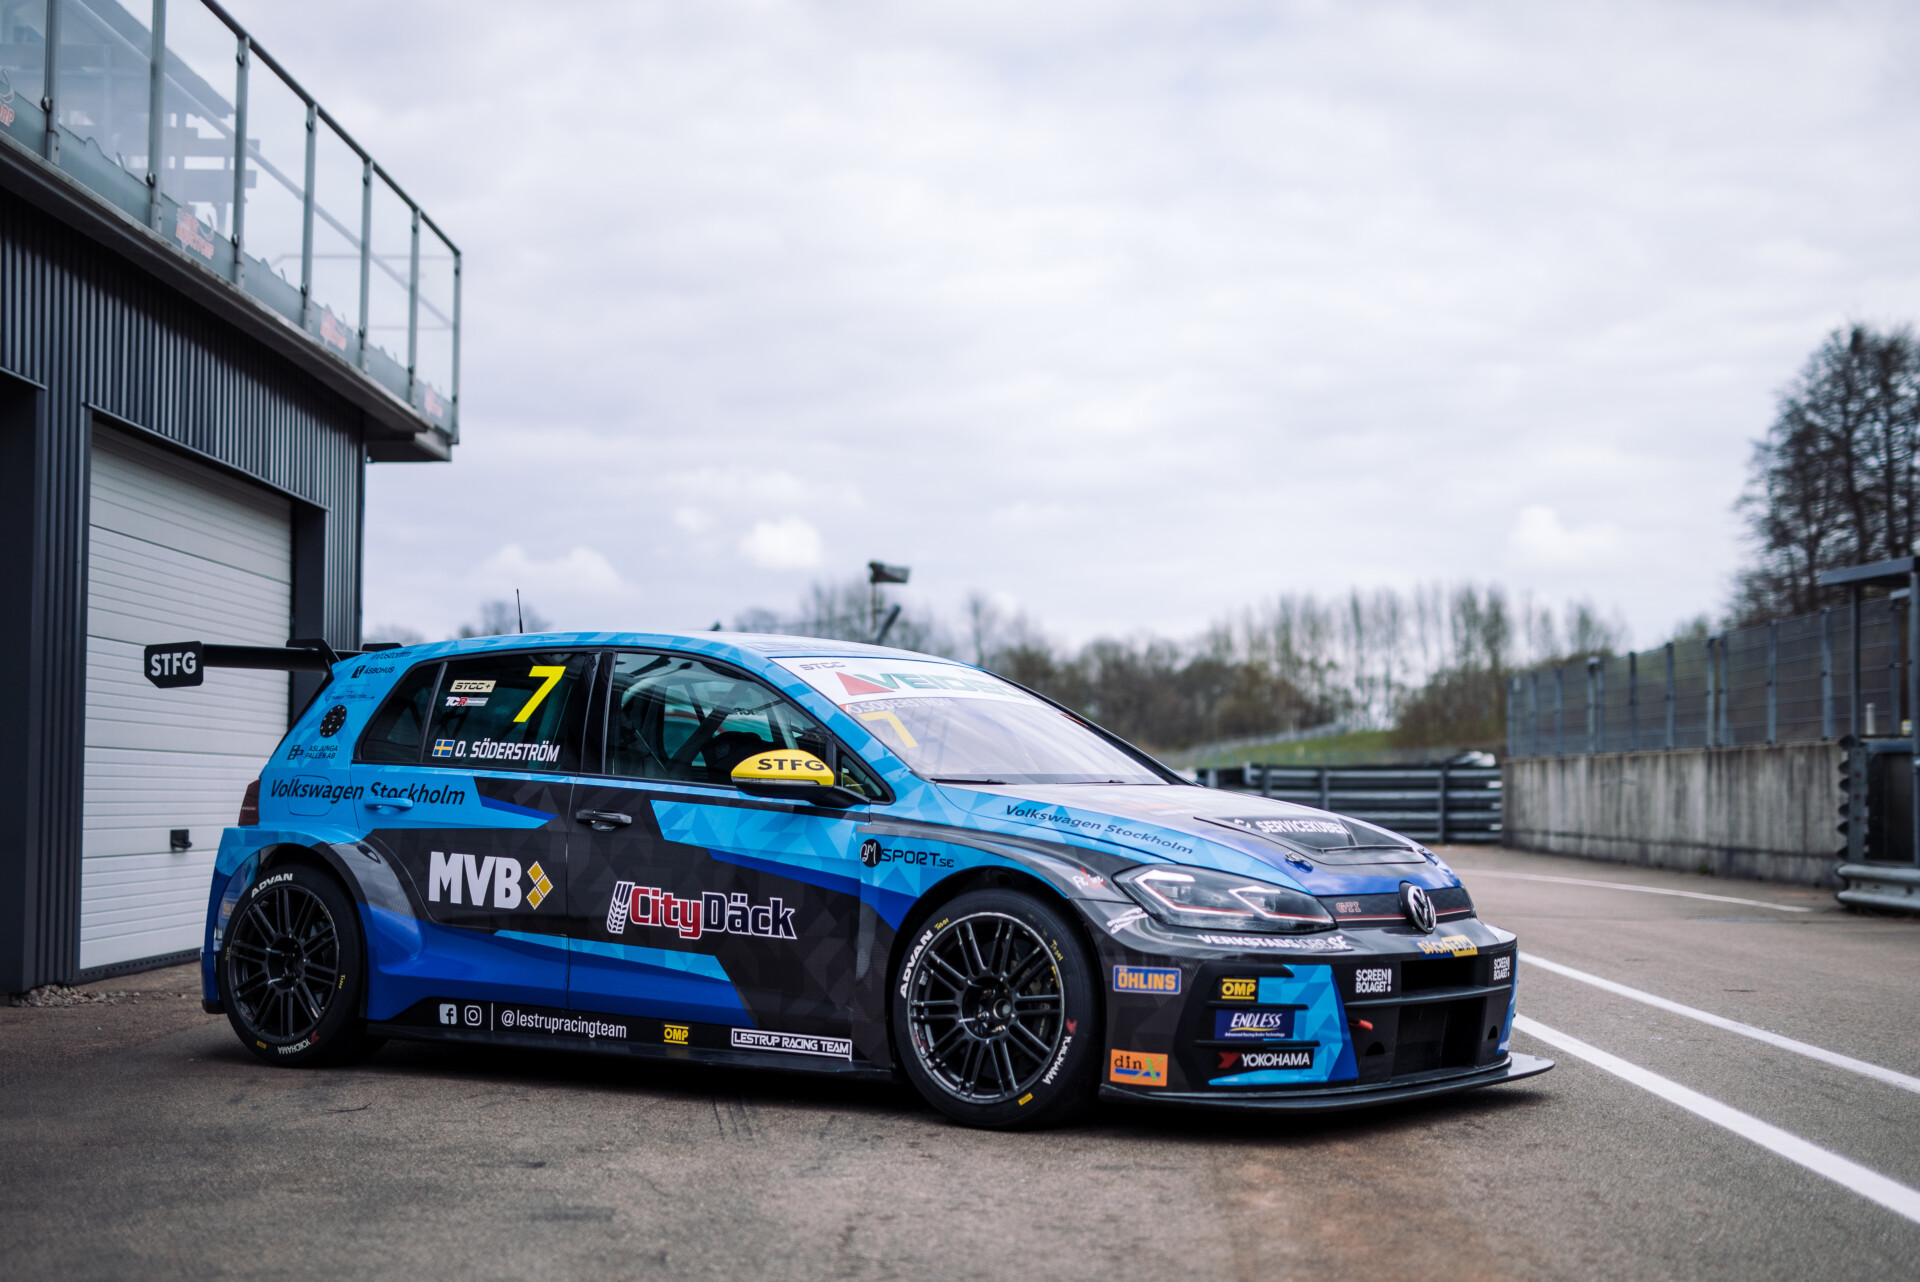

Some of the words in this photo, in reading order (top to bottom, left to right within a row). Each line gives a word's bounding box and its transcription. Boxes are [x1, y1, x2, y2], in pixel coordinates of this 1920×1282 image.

[150, 651, 197, 677] STFG
[799, 661, 846, 671] STCC
[445, 696, 468, 707] TCR
[513, 665, 567, 723] 7
[858, 710, 920, 749] 7
[326, 752, 337, 760] AB
[470, 738, 560, 763] SÖDERSTRÖM
[757, 757, 825, 772] STFG
[270, 776, 365, 804] Volkswagen
[370, 781, 466, 806] Stockholm
[1005, 804, 1101, 830] Volkswagen
[1104, 823, 1194, 855] Stockholm
[251, 873, 294, 899] ADVAN
[428, 850, 522, 910] MVB
[629, 885, 798, 940] CityDäck
[1335, 901, 1362, 914] GTI
[899, 929, 934, 999] ADVAN
[1355, 968, 1388, 982] SCREEN
[1117, 968, 1177, 991] ÖHLINS
[1221, 982, 1256, 996] OMP
[501, 1009, 627, 1039] @lestrupracingteam
[1230, 1012, 1283, 1028] ENDLESS
[663, 1027, 689, 1042] OMP
[733, 1032, 780, 1047] LESTRUP
[781, 1037, 818, 1051] RACING
[819, 1040, 849, 1054] TEAM
[277, 1037, 312, 1056] YOKOHAMA
[1042, 1035, 1073, 1085] YOKOHAMA
[1241, 1052, 1311, 1068] YOKOHAMA
